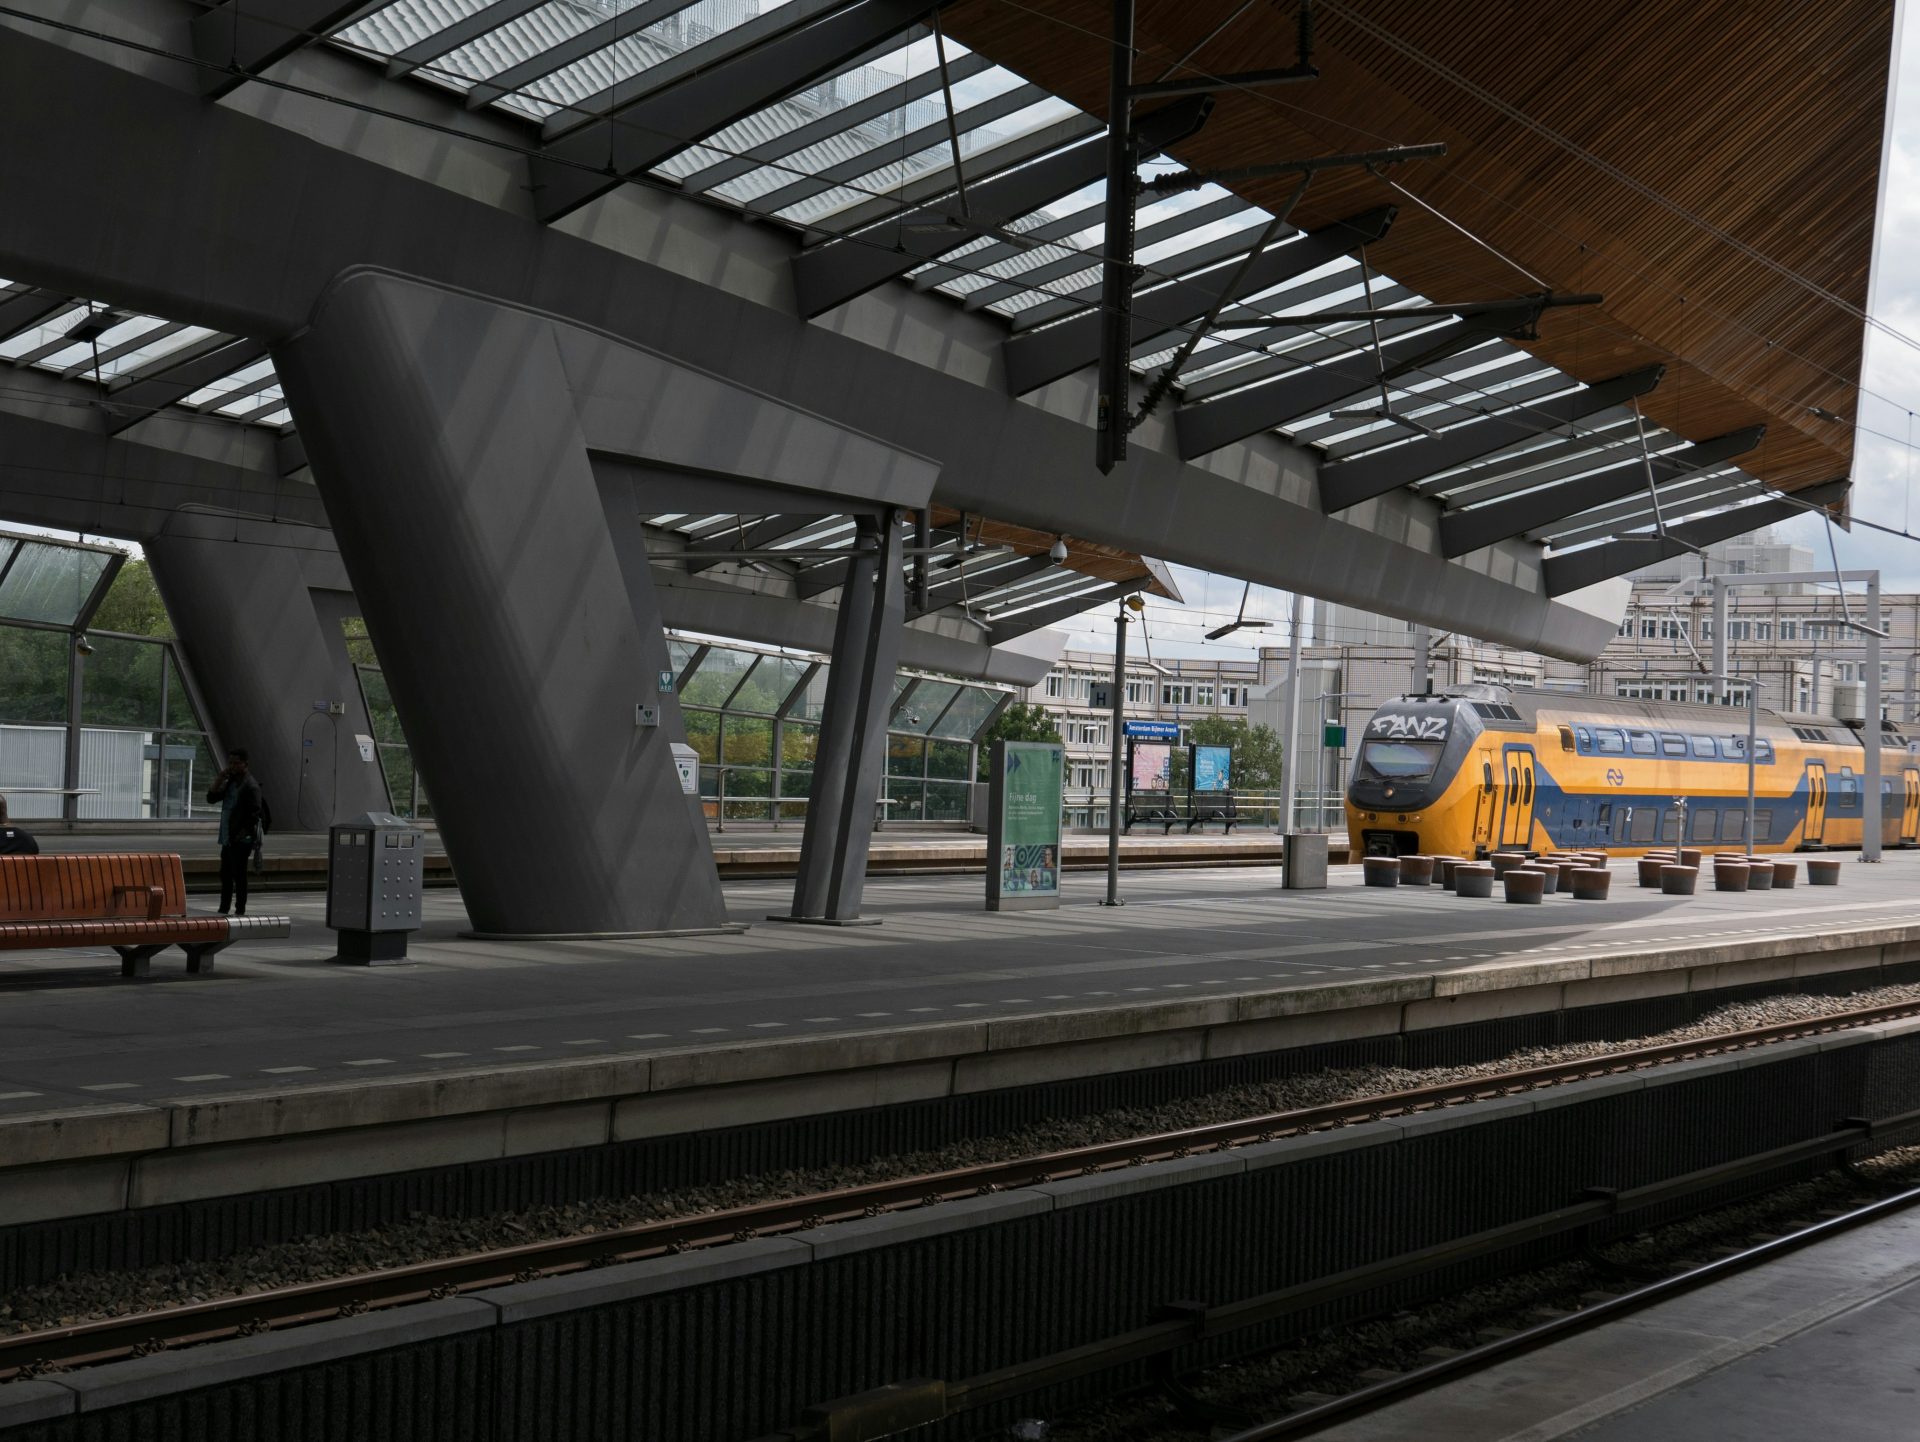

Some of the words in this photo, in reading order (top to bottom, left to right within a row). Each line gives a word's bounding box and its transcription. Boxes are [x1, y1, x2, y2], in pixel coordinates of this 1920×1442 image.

[1096, 691, 1106, 706] H
[1372, 714, 1448, 740] FANZ
[1736, 740, 1744, 749] G
[1009, 792, 1025, 804] Fijne
[1025, 792, 1037, 804] dag
[1626, 807, 1632, 821] 2
